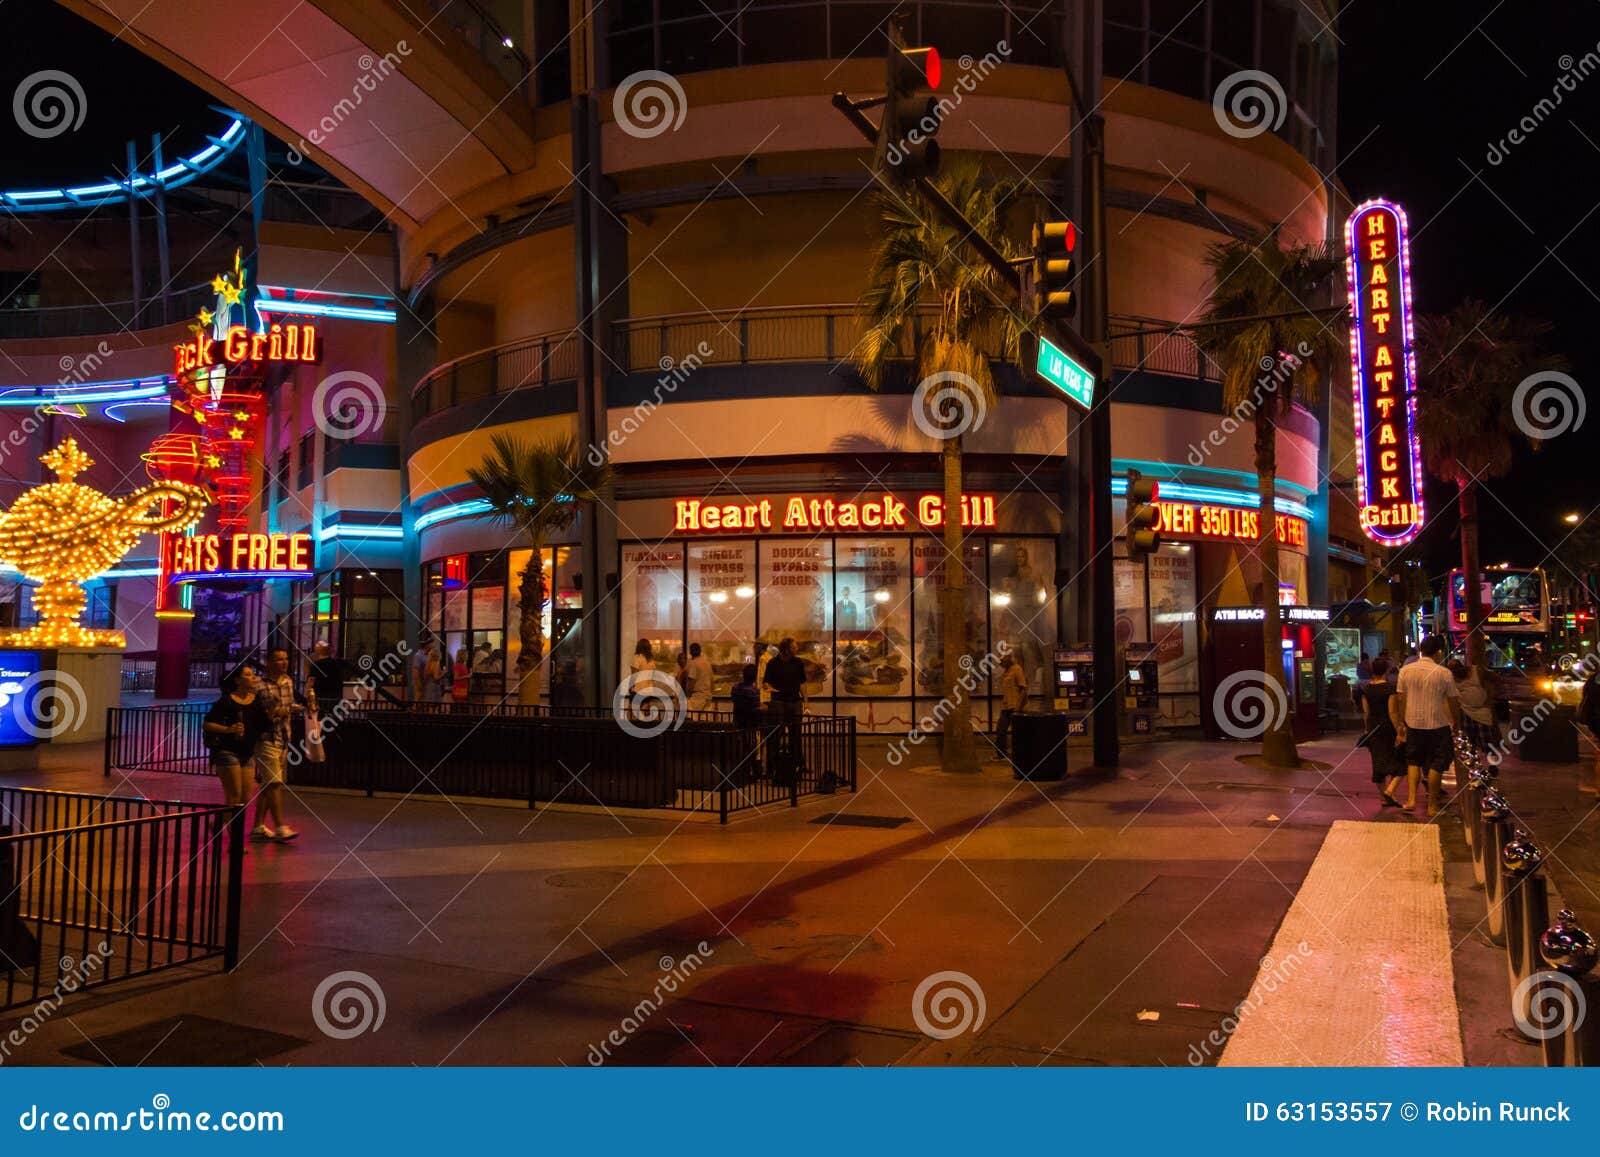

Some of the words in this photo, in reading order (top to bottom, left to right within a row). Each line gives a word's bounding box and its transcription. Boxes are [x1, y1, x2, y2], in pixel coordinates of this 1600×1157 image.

[1367, 214, 1391, 334] HEART
[224, 324, 316, 362] Grill
[1375, 346, 1400, 498] ATTACK
[675, 499, 772, 530] Heart
[784, 496, 906, 527] Attack
[918, 495, 997, 527] Gill
[1200, 505, 1230, 537] 350
[1234, 510, 1259, 539] LBS
[1287, 517, 1305, 546] FREE
[1361, 503, 1420, 527] Grill
[174, 534, 220, 574] EATS
[231, 532, 308, 571] FREE
